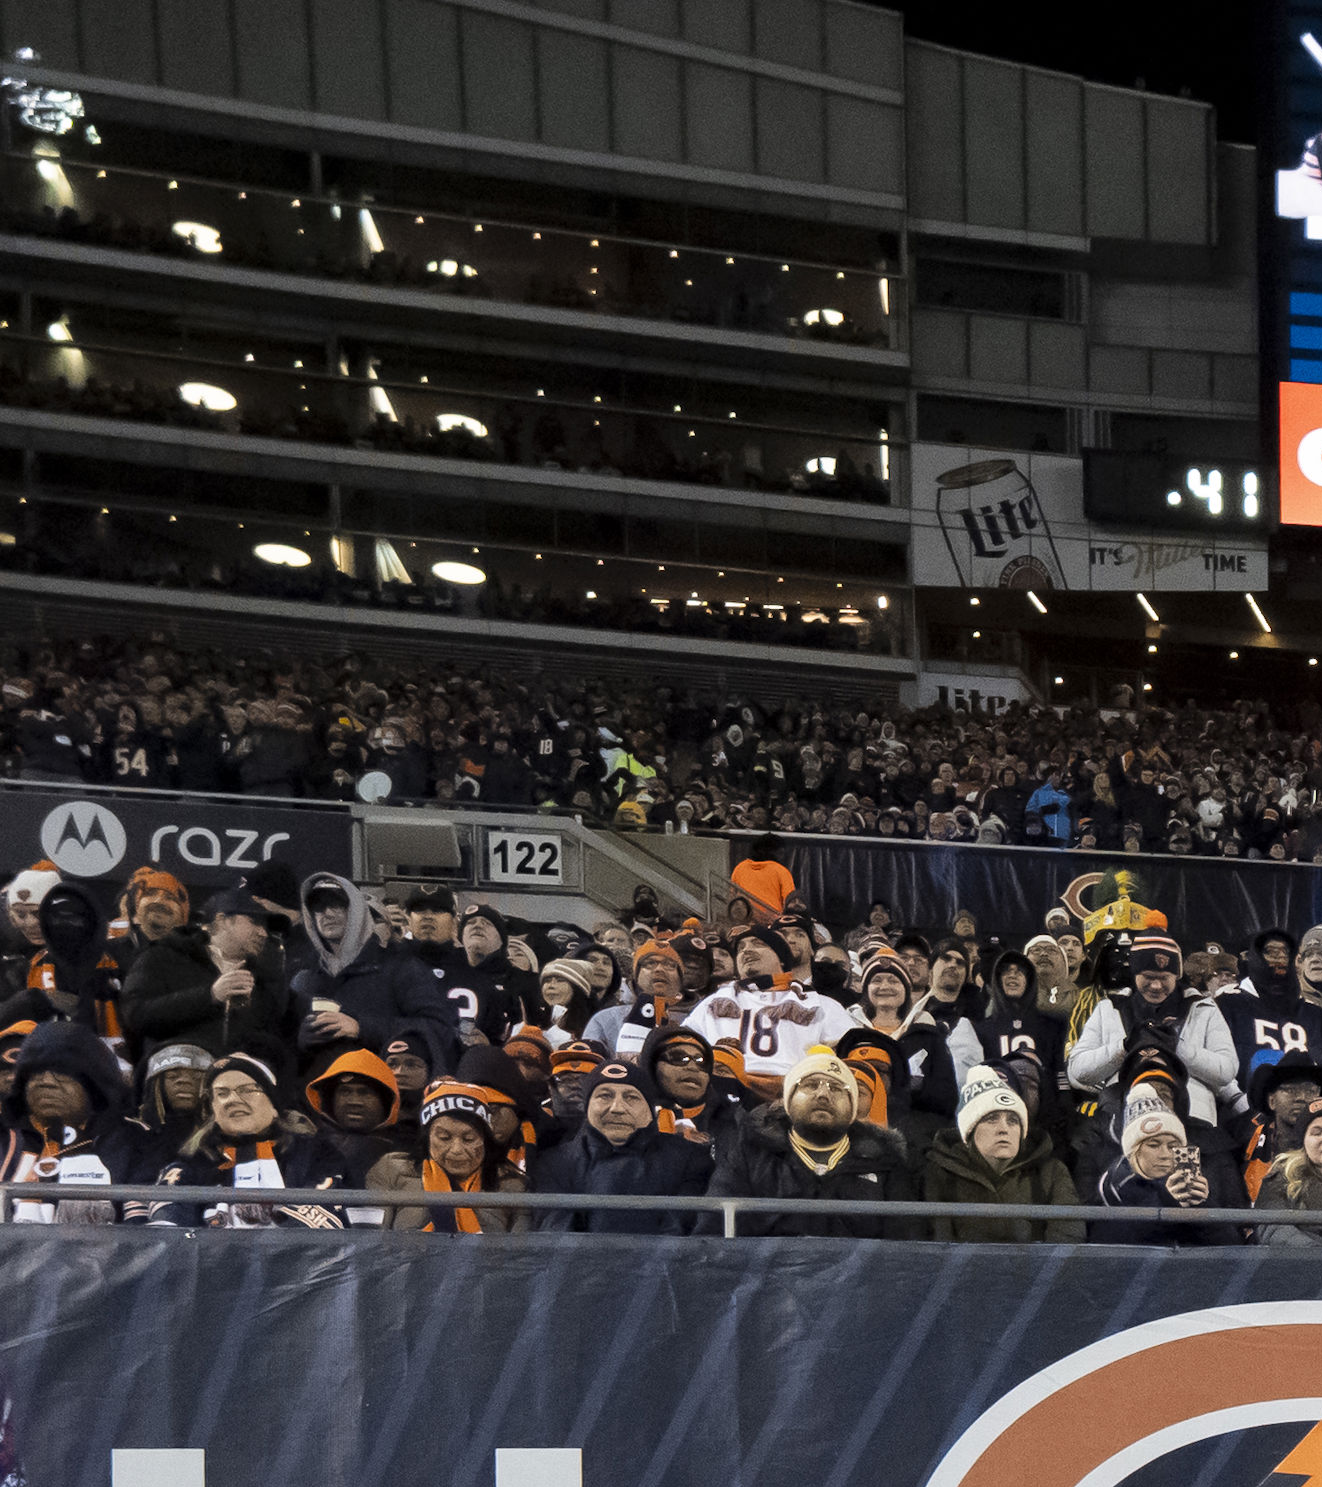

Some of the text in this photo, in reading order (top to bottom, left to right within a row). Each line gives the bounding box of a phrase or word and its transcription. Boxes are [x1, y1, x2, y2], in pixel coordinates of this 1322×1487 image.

[957, 496, 1038, 559] Lite
[1090, 546, 1123, 567] IT'S
[1200, 552, 1248, 574] TIME
[114, 747, 150, 777] 54
[150, 824, 291, 868] razr
[494, 838, 560, 878] 122
[738, 1003, 778, 1057] 18
[1254, 1018, 1309, 1053] 58
